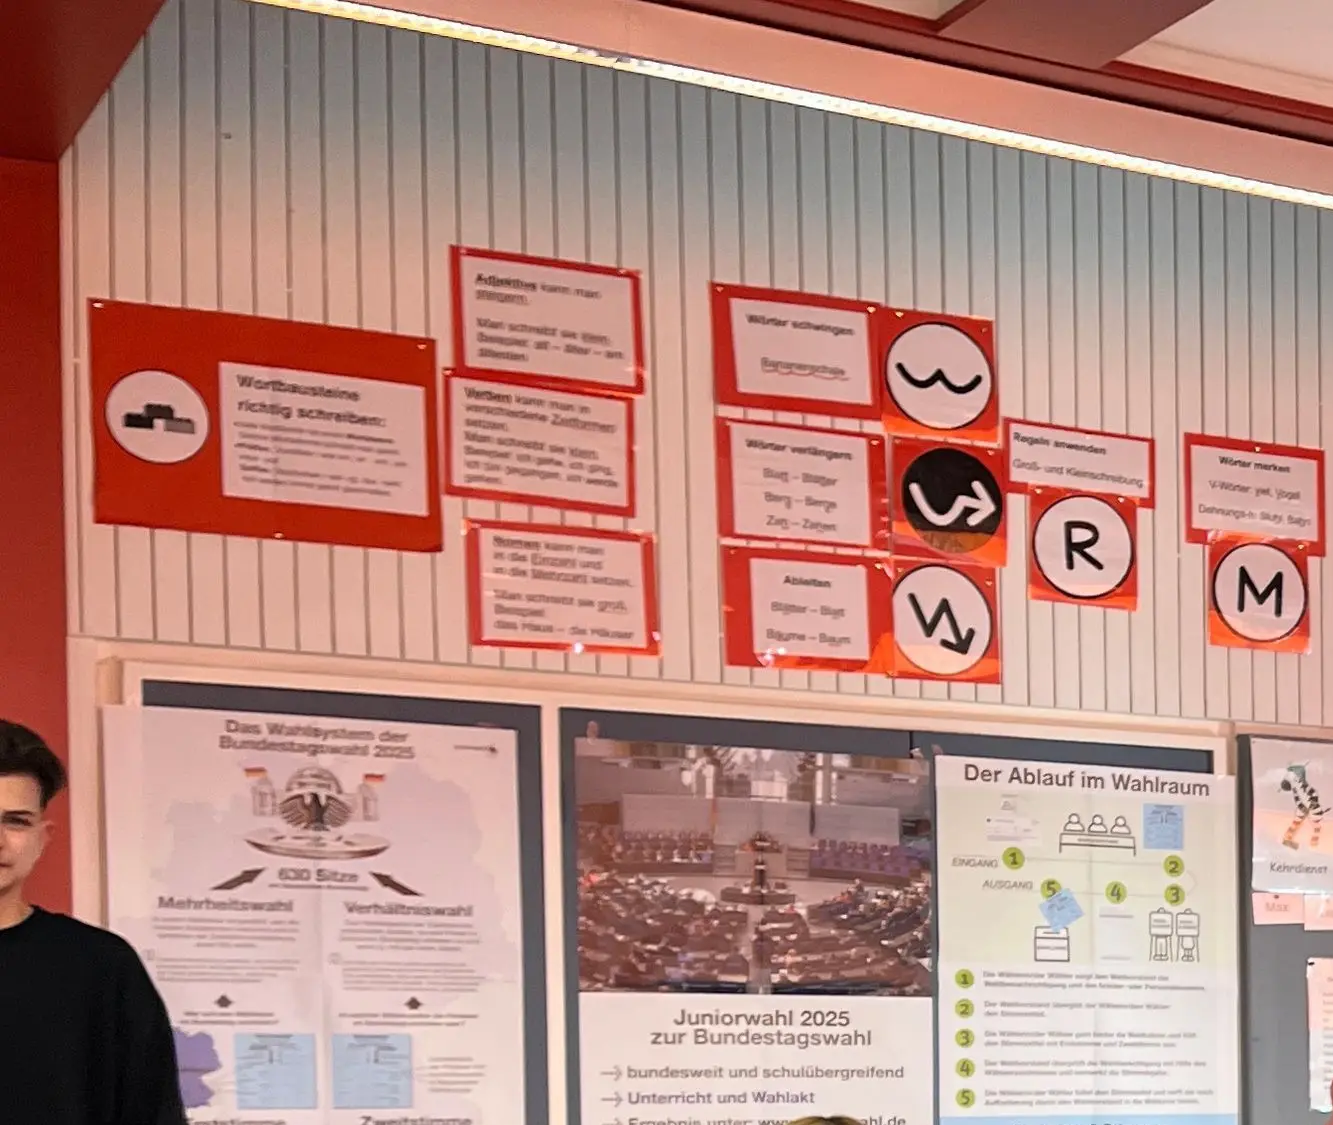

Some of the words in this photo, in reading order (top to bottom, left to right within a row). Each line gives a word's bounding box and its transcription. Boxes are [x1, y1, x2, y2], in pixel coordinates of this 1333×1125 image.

[238, 400, 292, 419] richtig
[1013, 432, 1050, 447] Regeln
[1054, 440, 1106, 455] anwenden
[1219, 456, 1251, 468] Wörter
[1254, 463, 1291, 473] merken
[1045, 465, 1064, 473] und
[1066, 467, 1143, 488] Kleinschreibung
[1064, 520, 1104, 570] R
[783, 575, 831, 588] Ableiten
[1237, 565, 1283, 618] M
[225, 720, 261, 735] Das
[379, 732, 409, 742] der
[219, 736, 369, 756] Bundestagswahl
[374, 744, 415, 759] 2025
[965, 765, 1001, 782] Der
[1008, 768, 1075, 787] Ablauf
[1081, 772, 1104, 789] im
[1112, 774, 1210, 796] Wahlraum
[952, 858, 998, 868] EINGANG
[1010, 852, 1018, 865] 1
[1168, 861, 1179, 873] 2
[1270, 862, 1328, 874] Kehrdienst
[315, 869, 359, 882] Sitze
[983, 880, 1033, 891] AUSGANG
[1047, 881, 1056, 896] 5
[1111, 885, 1121, 901] 4
[1170, 888, 1180, 902] 3
[157, 897, 293, 912] Mehrheitswahl
[343, 901, 473, 917] Verhältniswahl
[961, 974, 969, 985] 1
[960, 1003, 969, 1015] 2
[674, 1010, 793, 1027] Juniorwahl
[800, 1011, 850, 1027] 2025
[651, 1031, 685, 1045] zur
[693, 1029, 872, 1049] Bundestagswahl
[960, 1032, 969, 1045] 3
[627, 1066, 723, 1079] bundesweit
[729, 1066, 758, 1078] und
[763, 1066, 904, 1080] schulübergreifend
[960, 1062, 970, 1076] 4
[628, 1092, 712, 1104] Unterricht
[717, 1092, 746, 1104] und
[752, 1091, 815, 1104] Wahlakt
[961, 1091, 969, 1105] 5
